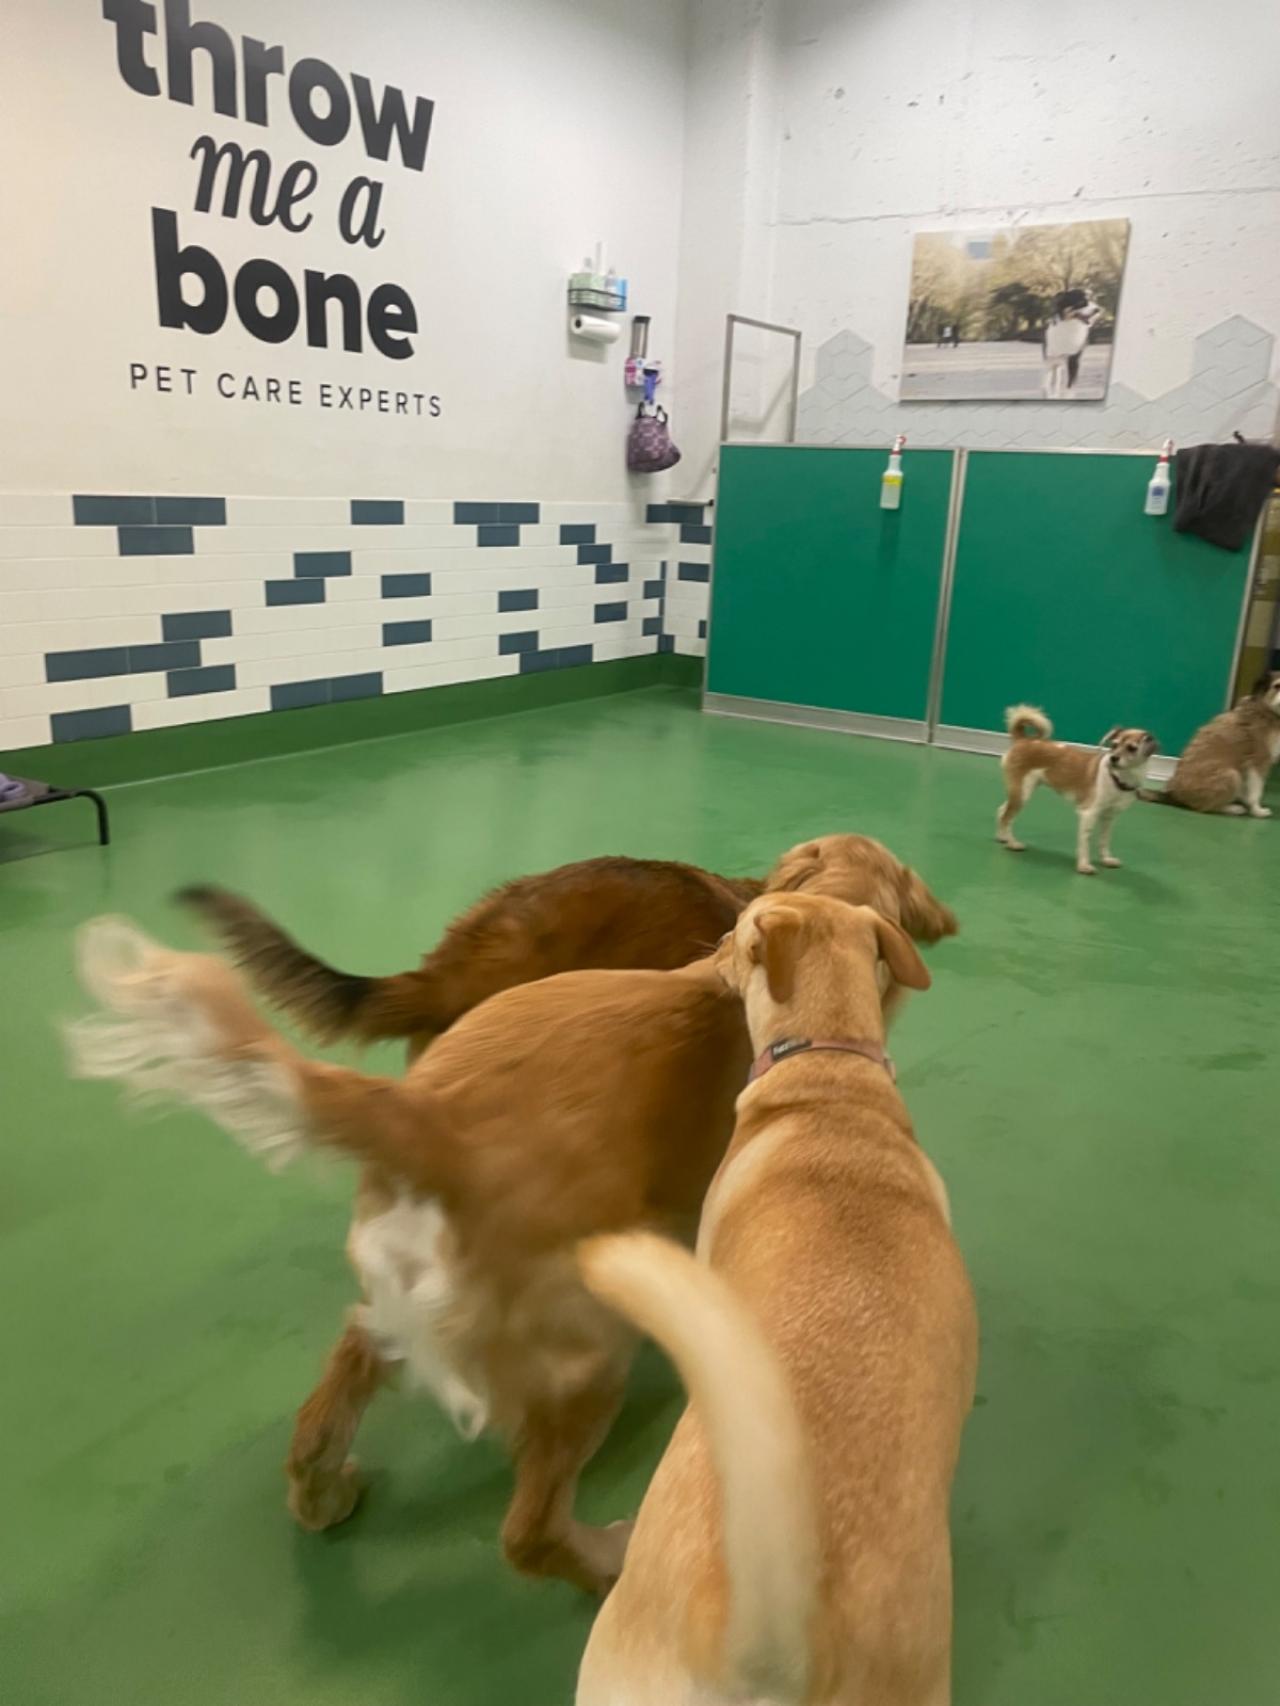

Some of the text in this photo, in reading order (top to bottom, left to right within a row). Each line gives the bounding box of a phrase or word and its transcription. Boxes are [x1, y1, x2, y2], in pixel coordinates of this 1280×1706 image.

[103, 0, 435, 172] throw
[190, 135, 386, 249] me a
[151, 206, 419, 360] bone
[129, 363, 443, 417] PET CARE EXPERTS
